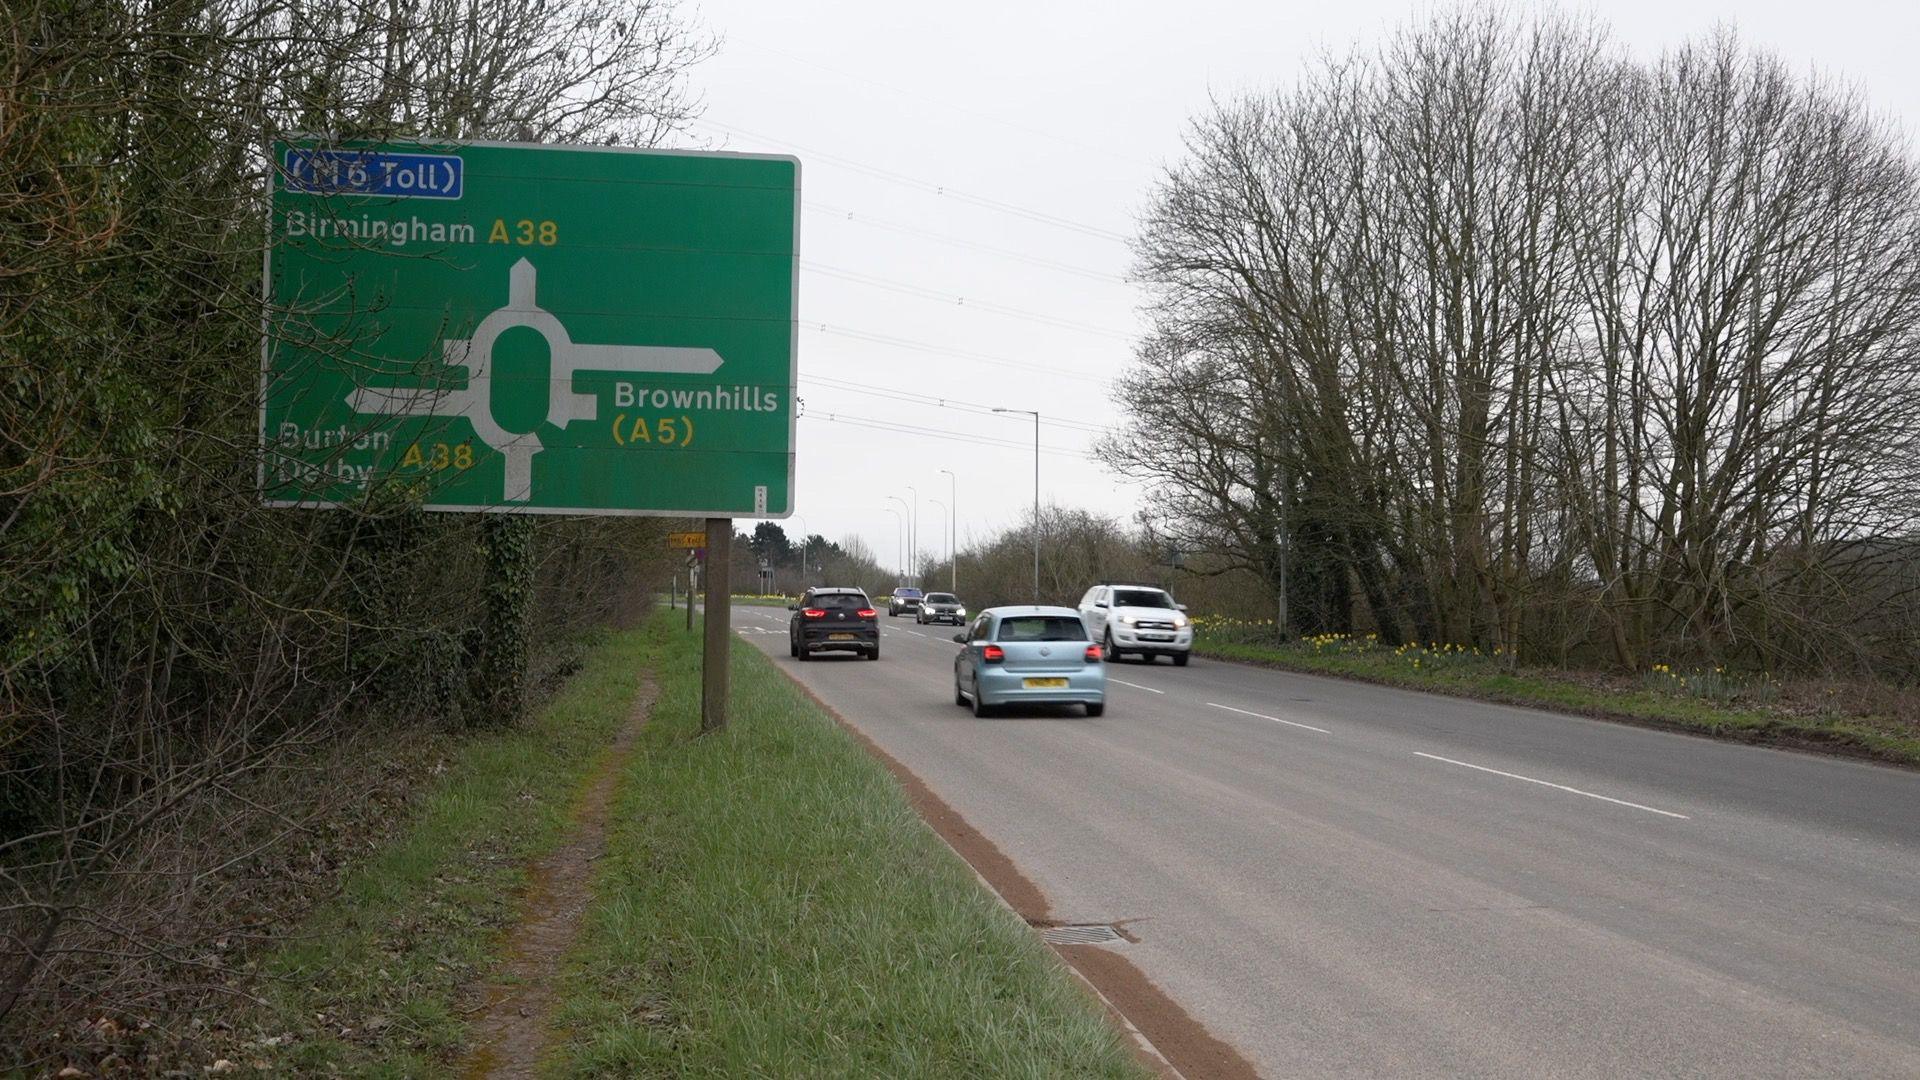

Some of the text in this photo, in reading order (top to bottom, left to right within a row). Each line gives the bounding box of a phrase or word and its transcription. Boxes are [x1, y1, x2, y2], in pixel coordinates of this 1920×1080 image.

[380, 161, 455, 194] Toll)
[287, 212, 474, 246] Birmingham
[615, 382, 777, 412] Brownhills
[280, 423, 390, 450] Burton
